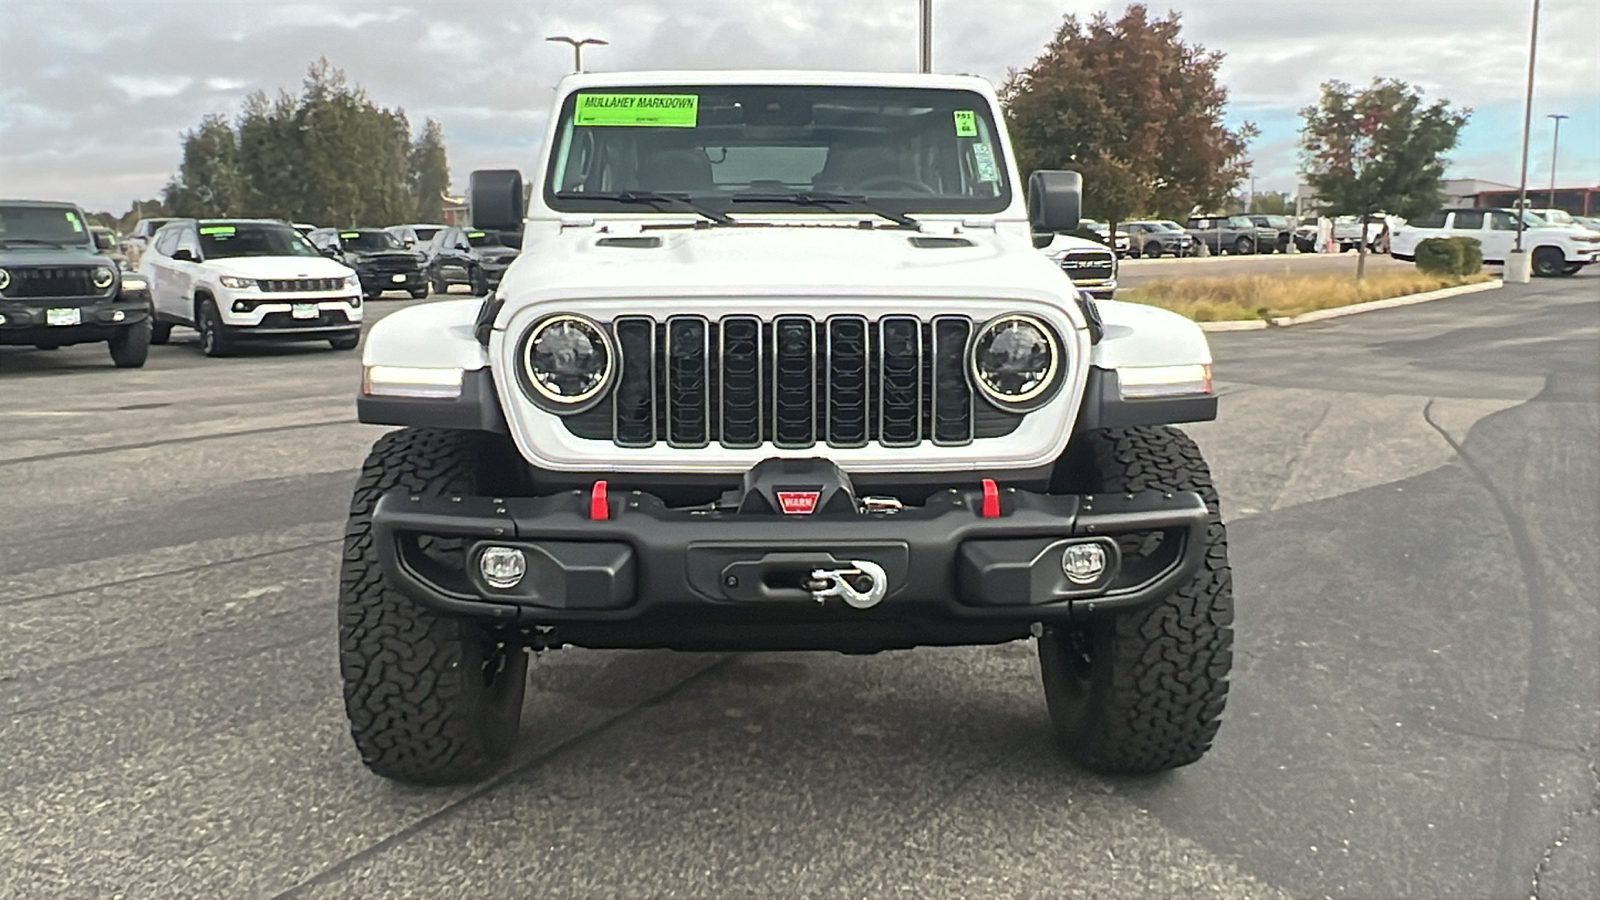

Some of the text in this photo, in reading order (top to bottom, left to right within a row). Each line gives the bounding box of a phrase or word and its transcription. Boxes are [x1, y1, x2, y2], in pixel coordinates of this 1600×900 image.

[584, 97, 695, 109] MULLAHEY MARKDOWN
[784, 497, 813, 507] WARN
